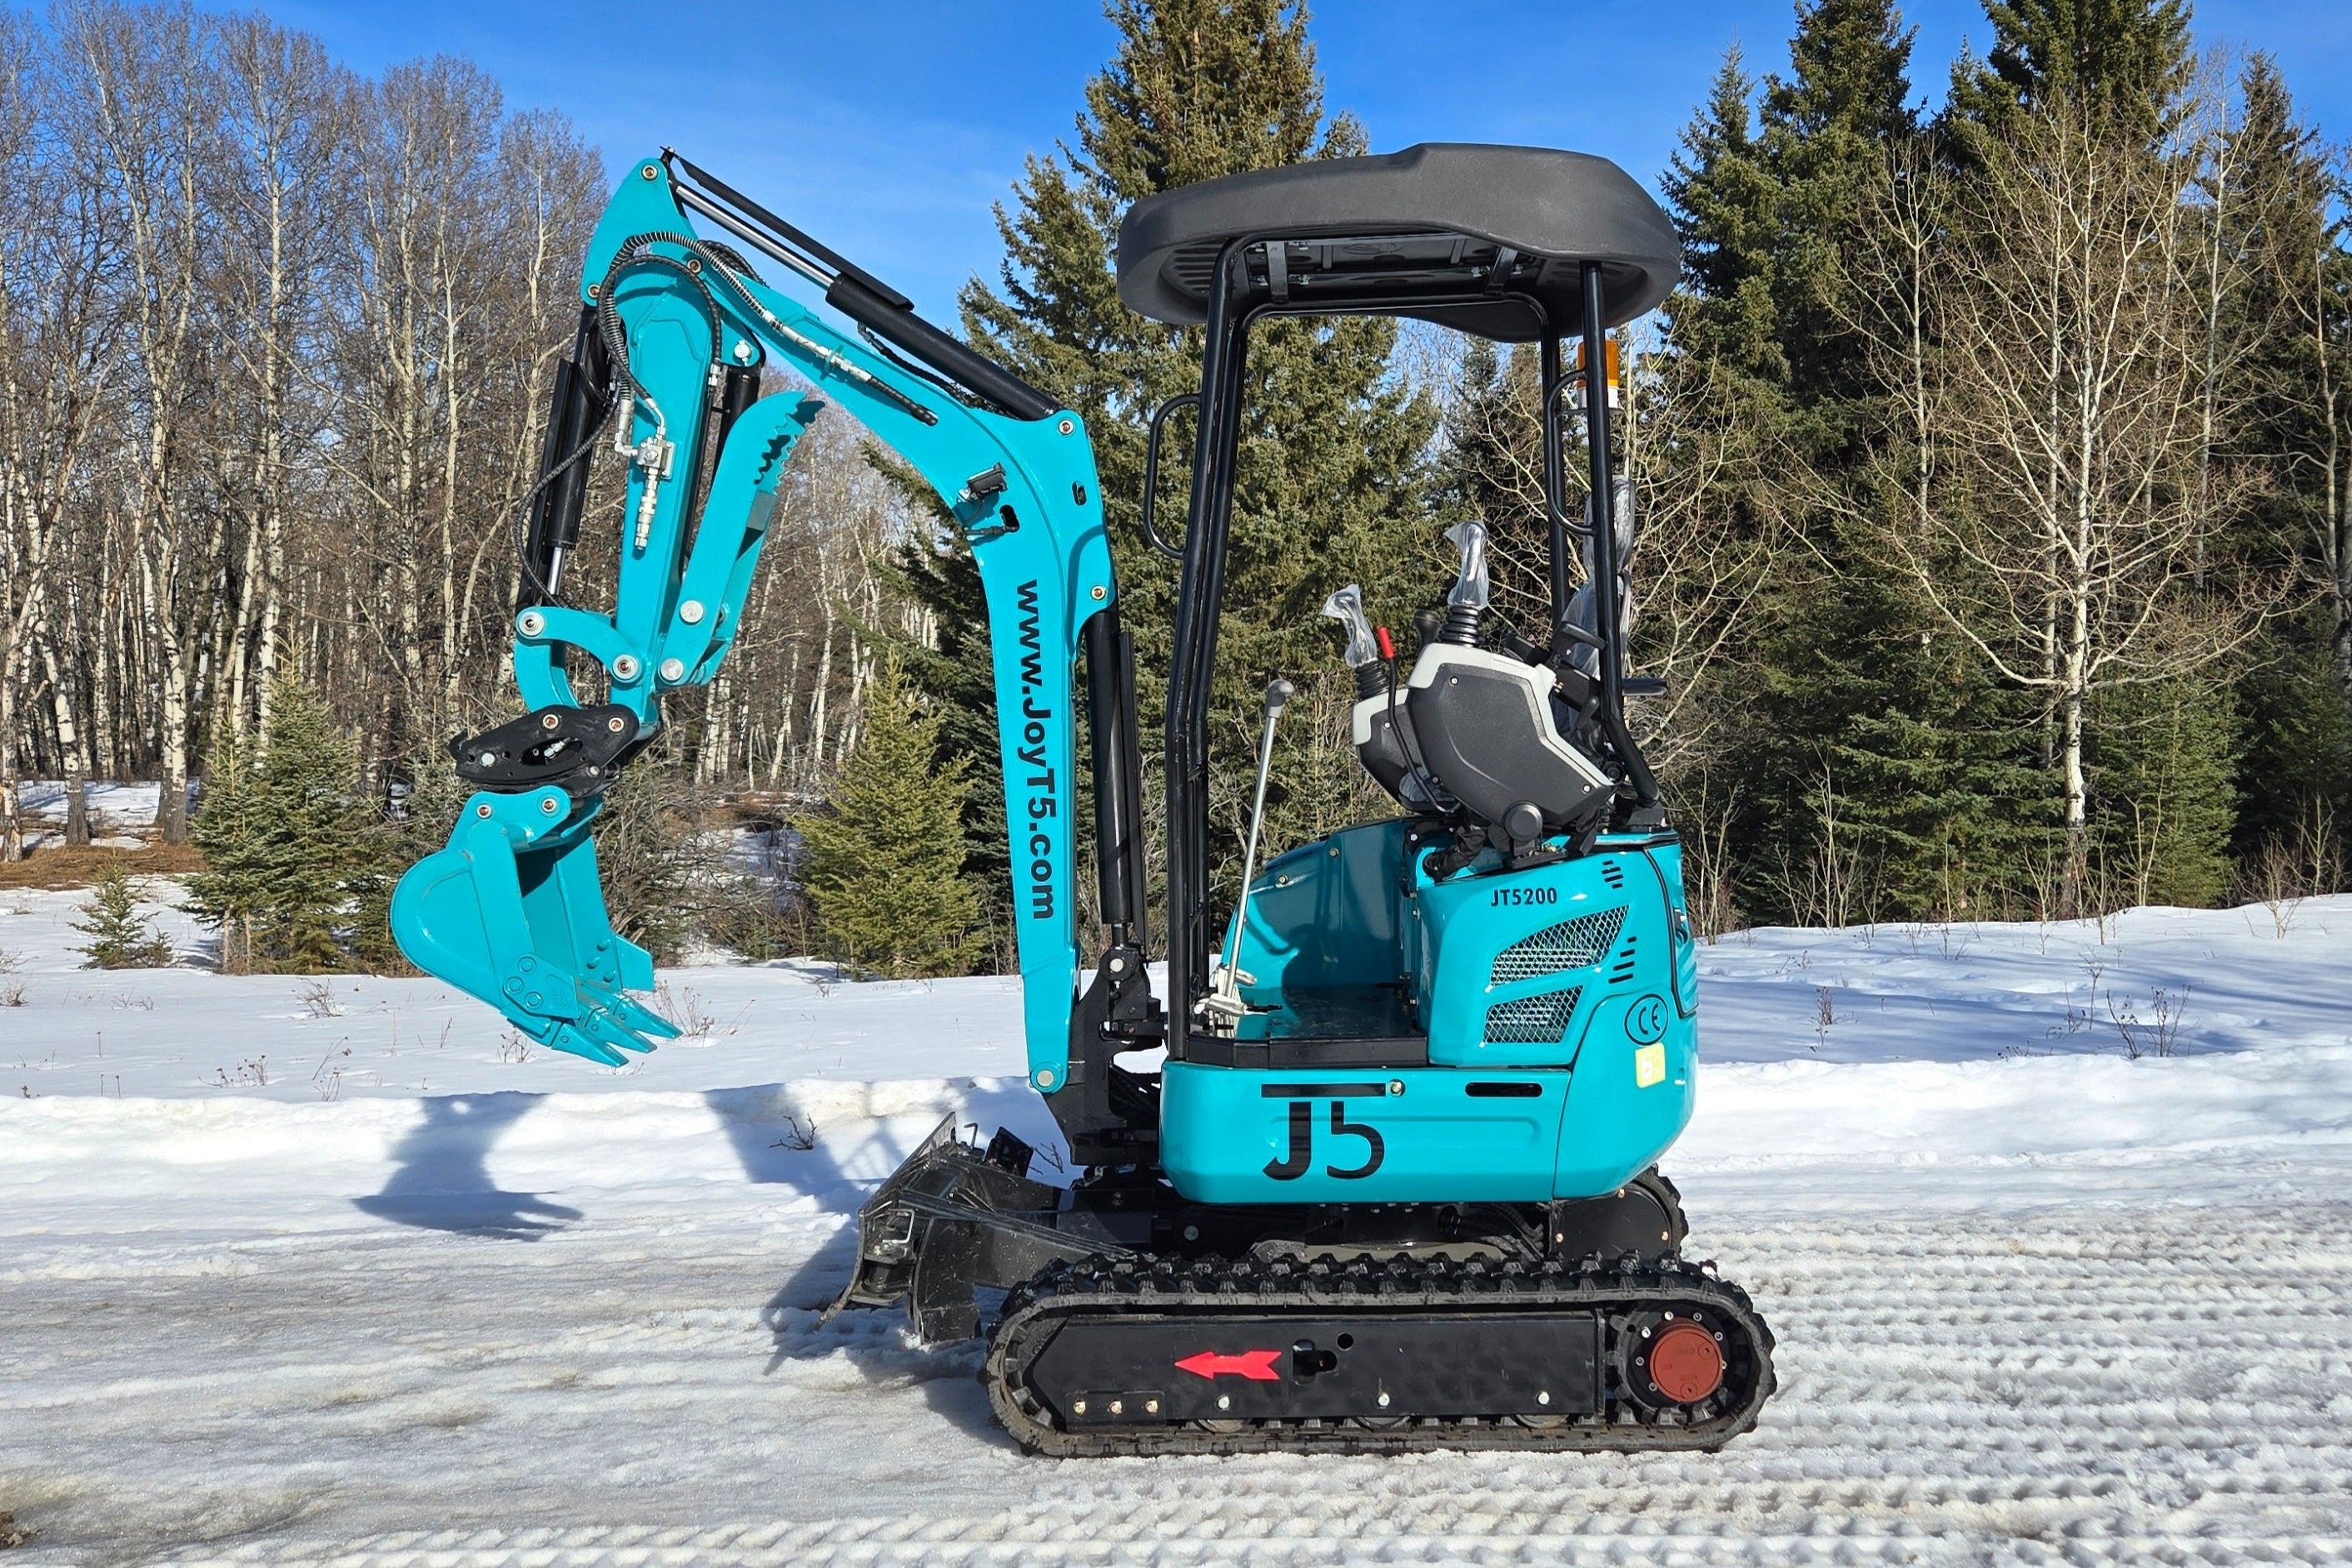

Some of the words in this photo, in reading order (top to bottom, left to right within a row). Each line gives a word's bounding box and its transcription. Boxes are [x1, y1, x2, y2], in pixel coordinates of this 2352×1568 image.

[1016, 579, 1057, 920] www.JoyT5.com
[1490, 887, 1557, 907] JT5200
[1262, 1083, 1386, 1181] J5
